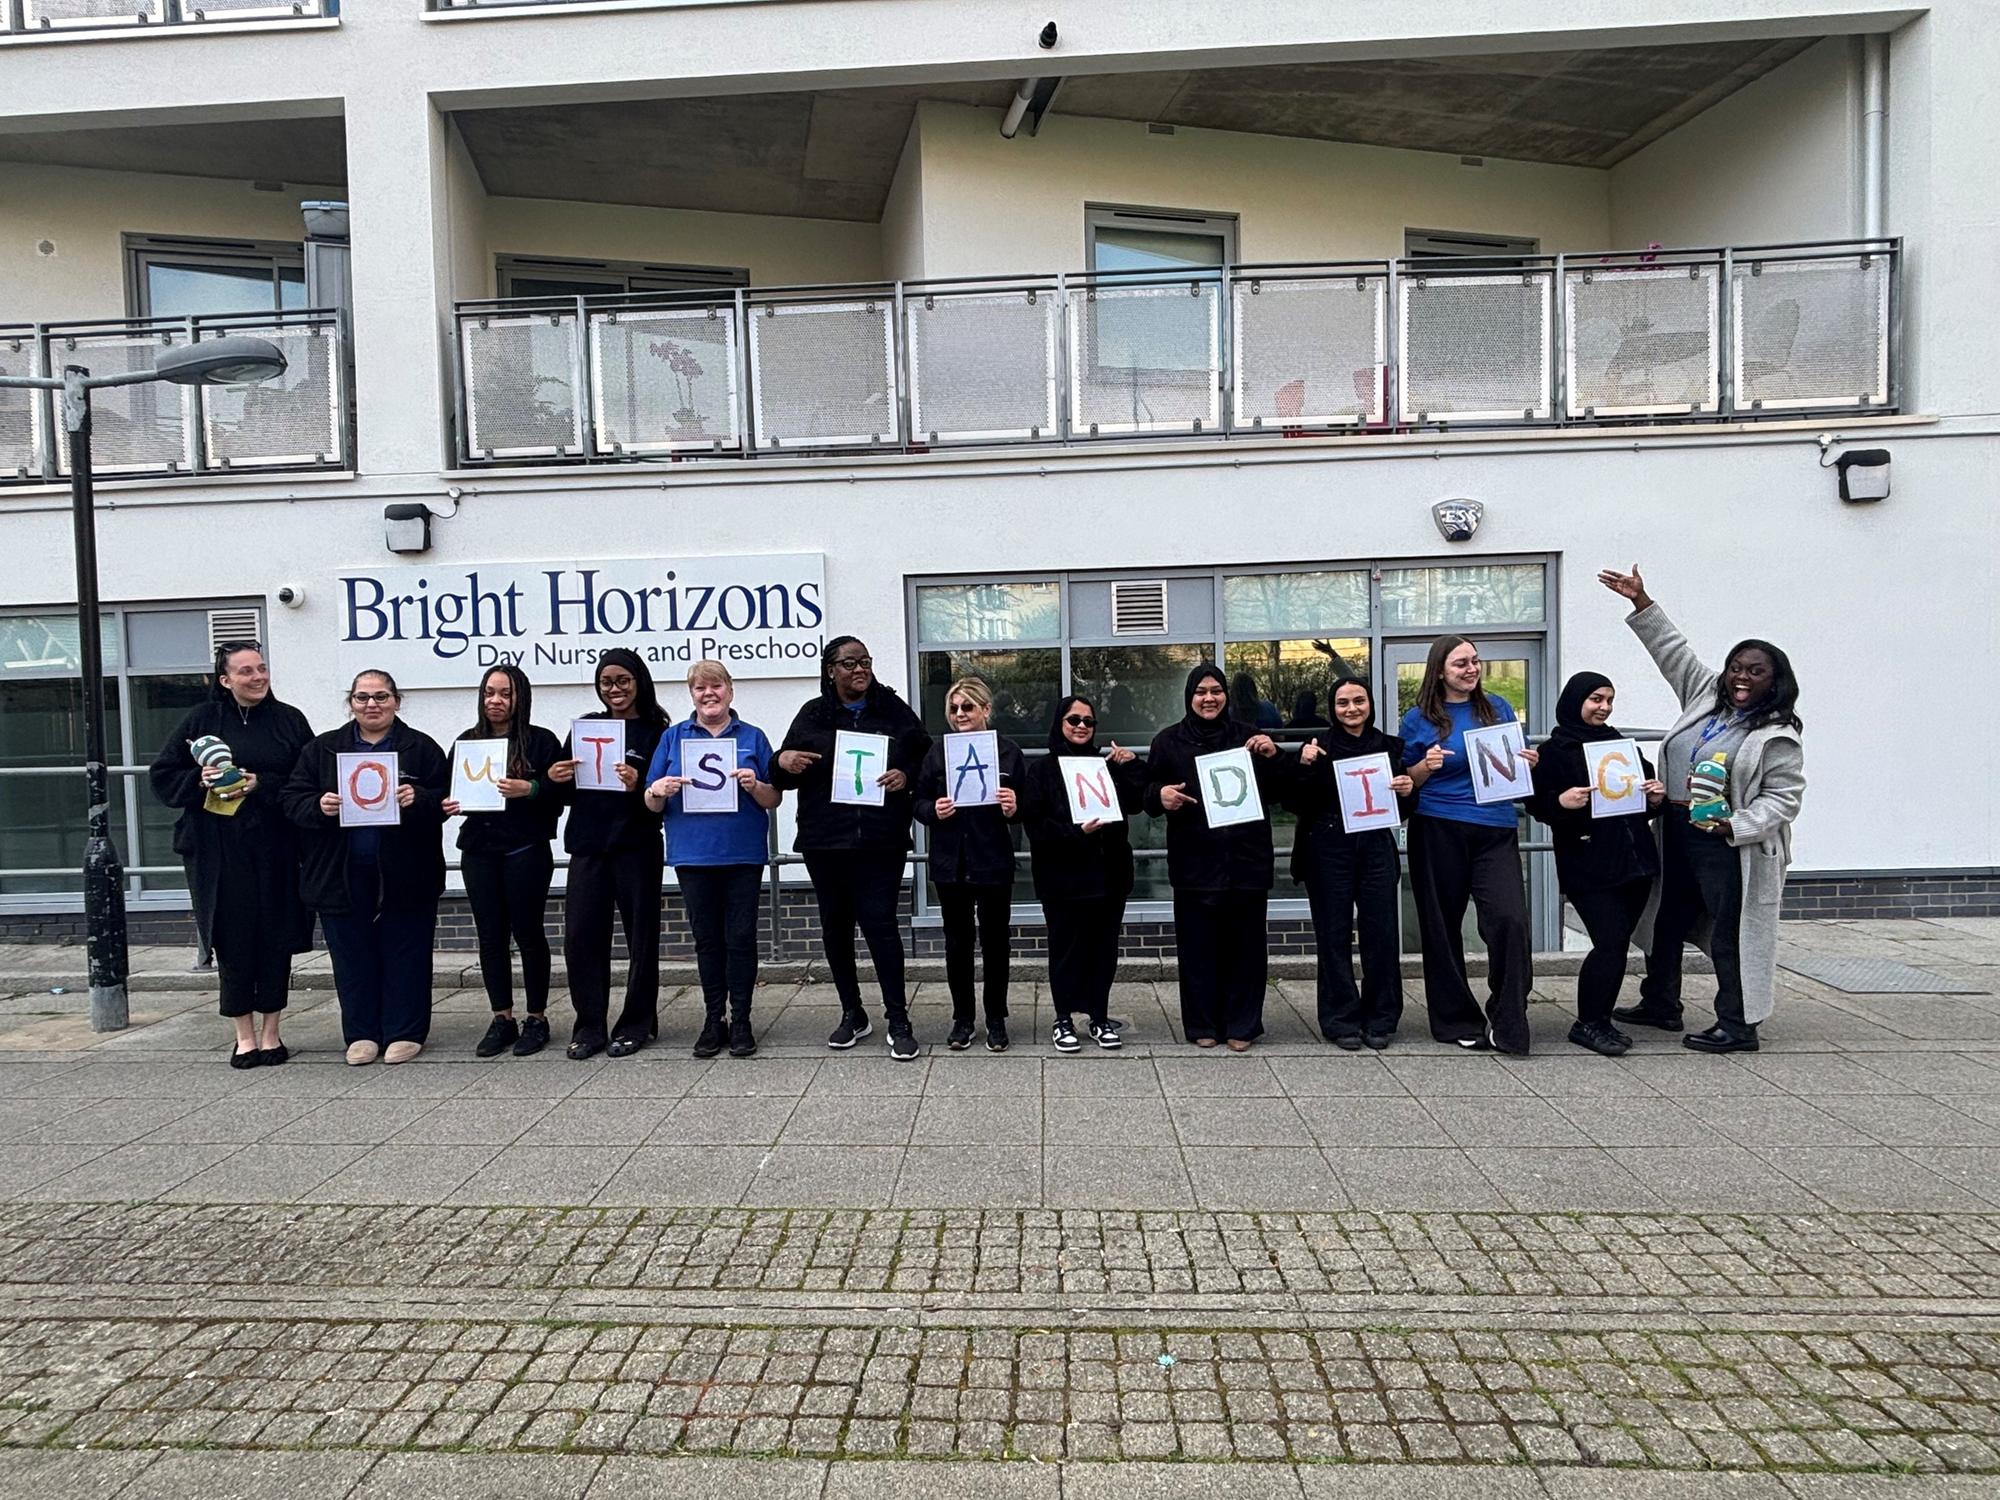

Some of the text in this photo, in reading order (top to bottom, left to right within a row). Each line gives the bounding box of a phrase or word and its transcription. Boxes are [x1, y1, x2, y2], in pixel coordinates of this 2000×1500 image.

[338, 570, 822, 658] Bright Horizons
[478, 635, 824, 667] Day Nurs and Preschool
[581, 736, 616, 784] T
[690, 753, 727, 791] S
[846, 749, 875, 796] T
[954, 742, 989, 802] A
[1476, 734, 1517, 788] N
[1597, 751, 1638, 801] G
[349, 760, 391, 811] O
[1076, 772, 1110, 810] N
[1210, 764, 1249, 808] D
[1344, 766, 1390, 817] I
